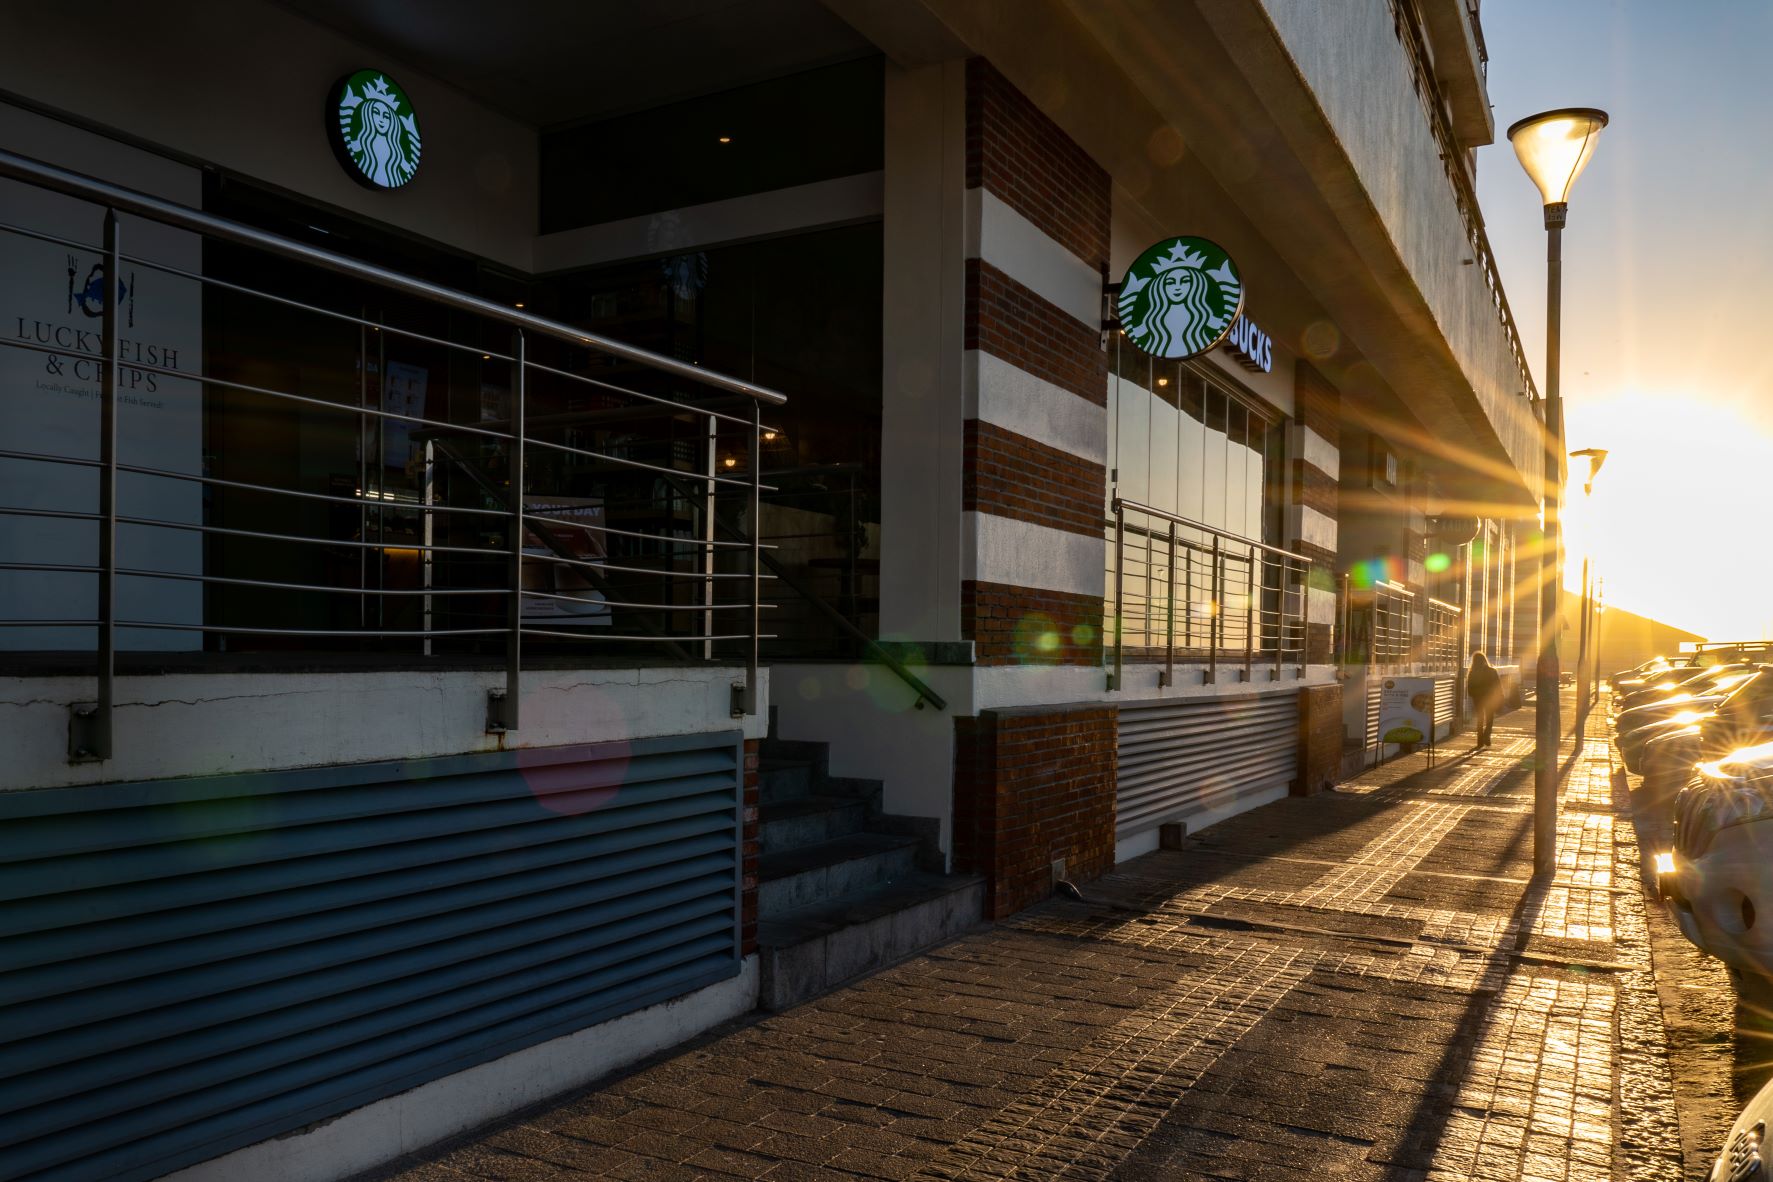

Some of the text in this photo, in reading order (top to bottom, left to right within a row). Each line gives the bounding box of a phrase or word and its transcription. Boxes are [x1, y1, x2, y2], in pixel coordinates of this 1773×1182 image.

[118, 338, 179, 369] FISH
[1227, 313, 1272, 373] BUCKS
[46, 354, 64, 376] &
[574, 506, 601, 517] DAY
